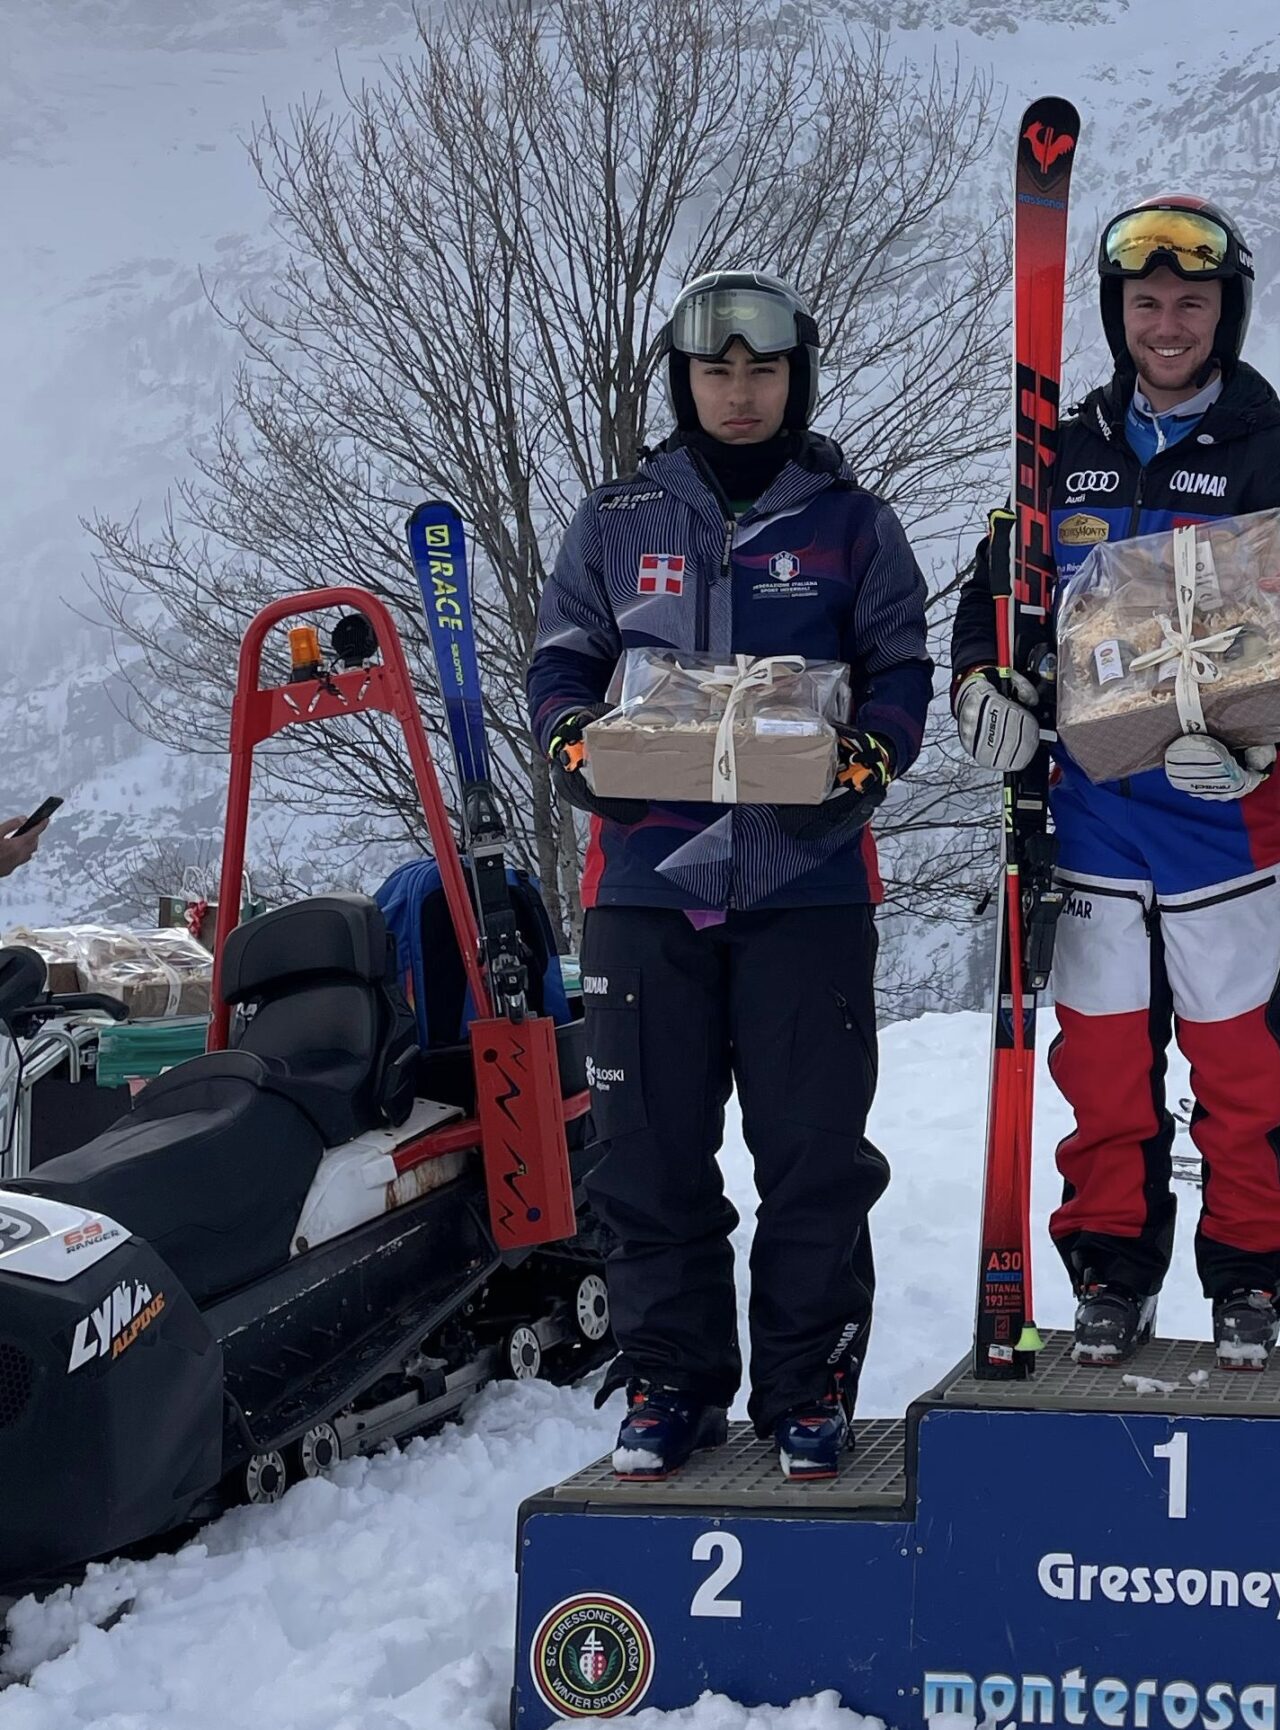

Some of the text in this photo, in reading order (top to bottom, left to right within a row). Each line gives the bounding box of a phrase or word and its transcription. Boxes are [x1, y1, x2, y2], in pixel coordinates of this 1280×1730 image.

[1065, 494, 1086, 504] Audi
[1169, 470, 1228, 497] COLMAR
[987, 709, 999, 748] reusch
[63, 1221, 103, 1247] 69
[66, 1229, 120, 1254] RANGER
[987, 1252, 1021, 1271] A30
[985, 1284, 1021, 1293] TITANAL
[985, 1295, 1003, 1306] 193
[112, 1291, 166, 1360] ALPINE
[827, 1322, 860, 1365] COLMAR
[1153, 1431, 1189, 1519] 1
[689, 1531, 743, 1618] 2
[552, 1609, 618, 1641] GRESSONEY
[626, 1637, 639, 1673] ROSA
[552, 1677, 629, 1709] WINTER SPORT
[923, 1667, 1278, 1730] monterosa
